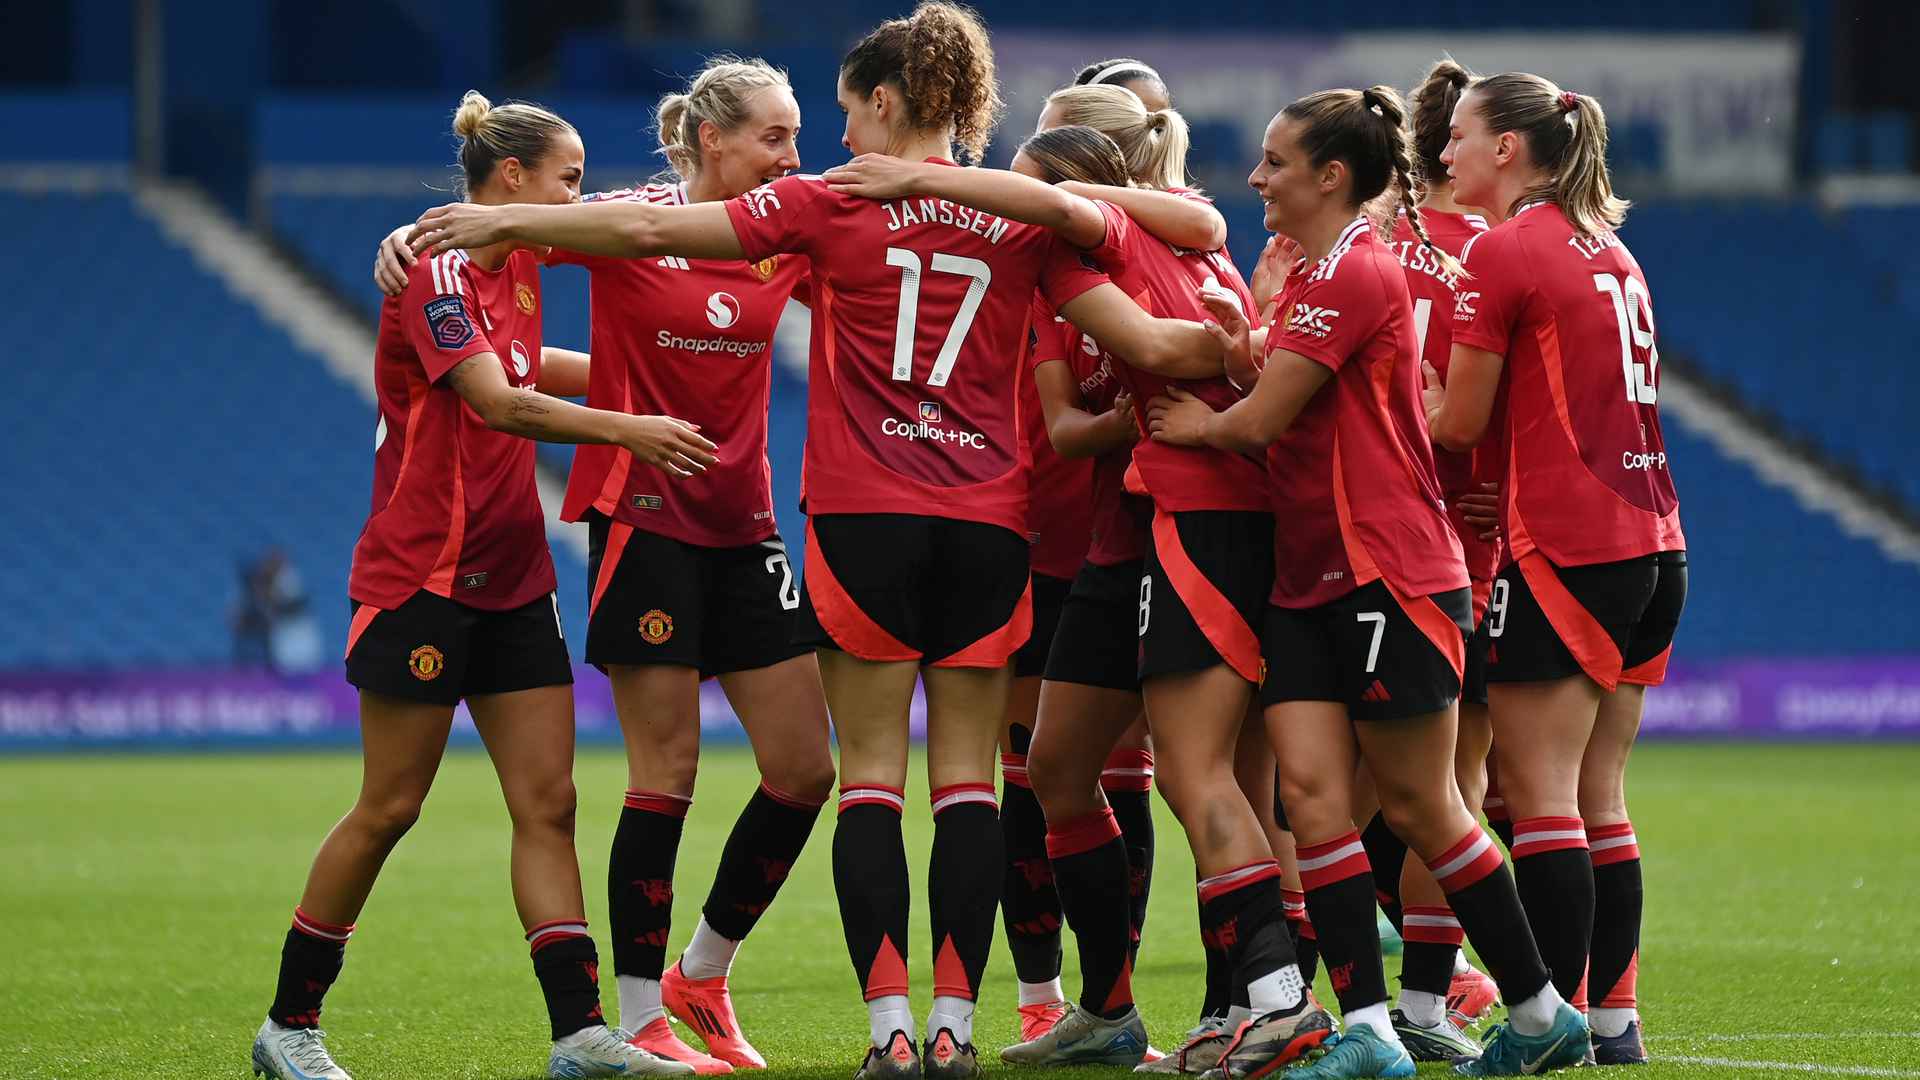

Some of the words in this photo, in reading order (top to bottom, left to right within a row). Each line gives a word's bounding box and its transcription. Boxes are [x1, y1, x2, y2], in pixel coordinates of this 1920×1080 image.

[749, 183, 781, 217] XC
[881, 199, 1009, 245] JANSSEN
[886, 247, 991, 387] 17
[1454, 291, 1481, 314] XC
[656, 330, 766, 357] Snapdragon
[1593, 273, 1660, 405] 19
[765, 553, 799, 611] 2
[1357, 611, 1387, 673] 7
